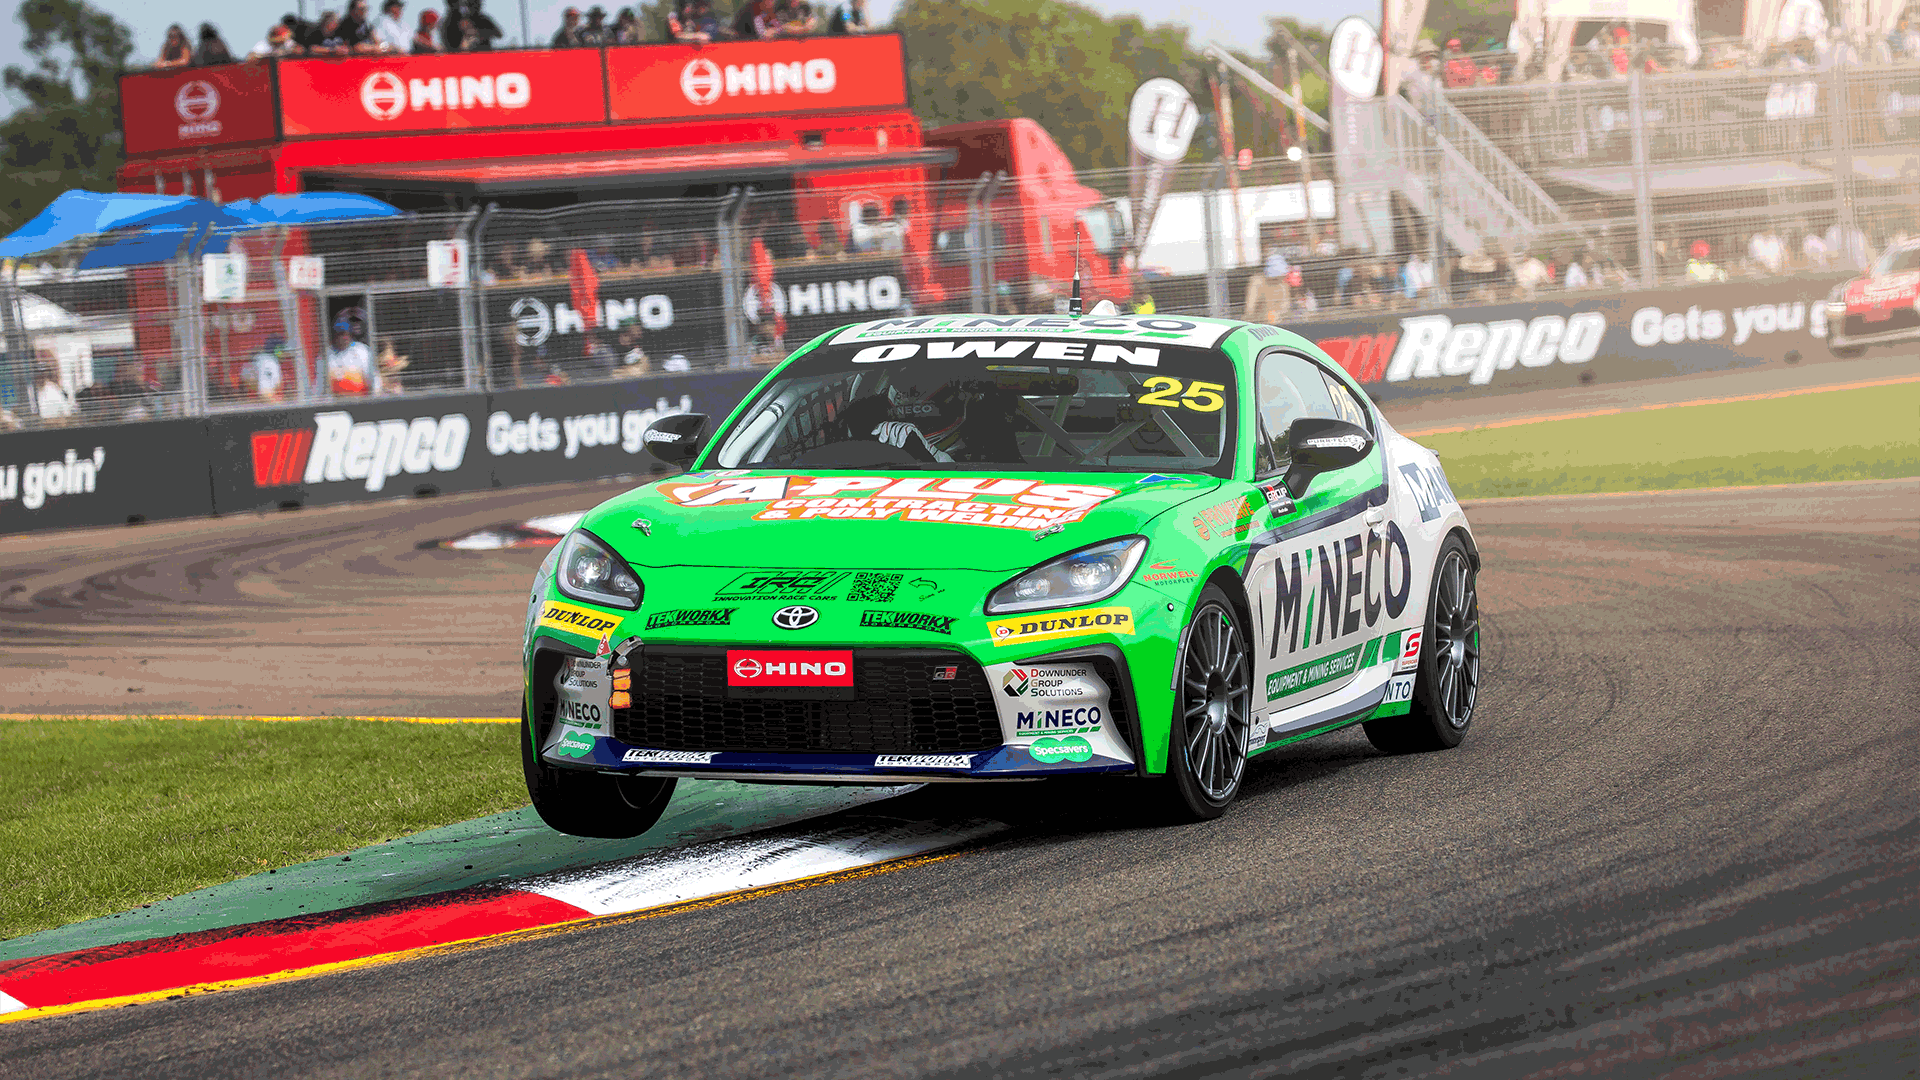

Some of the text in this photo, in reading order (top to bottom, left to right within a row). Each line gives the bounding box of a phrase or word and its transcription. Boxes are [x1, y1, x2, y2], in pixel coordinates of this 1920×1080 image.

[408, 72, 531, 111] HINO
[724, 58, 837, 96] HINO
[1140, 93, 1190, 139] H
[788, 275, 901, 316] HINO
[1630, 305, 1727, 346] Gets
[1731, 300, 1806, 345] you
[851, 341, 1161, 367] OWEN
[1387, 314, 1607, 384] Repco
[1137, 376, 1226, 412] 25
[486, 394, 693, 459] Gets you go'
[305, 410, 470, 492] Repco
[22, 446, 106, 510] goin'
[758, 509, 791, 519] &
[799, 507, 900, 519] POLY
[1143, 570, 1199, 582] NORWELL
[544, 607, 616, 632] DUNLOP
[1019, 614, 1129, 634] DUNLOP
[765, 661, 847, 676] HINO
[1031, 668, 1087, 678] DOWNUNDER
[1031, 679, 1063, 687] GROUP
[1267, 652, 1355, 696] EQUIPMENT & MINING SERVICES
[1031, 688, 1083, 697] SOLUTIONS
[1034, 745, 1088, 756] Specsavers
